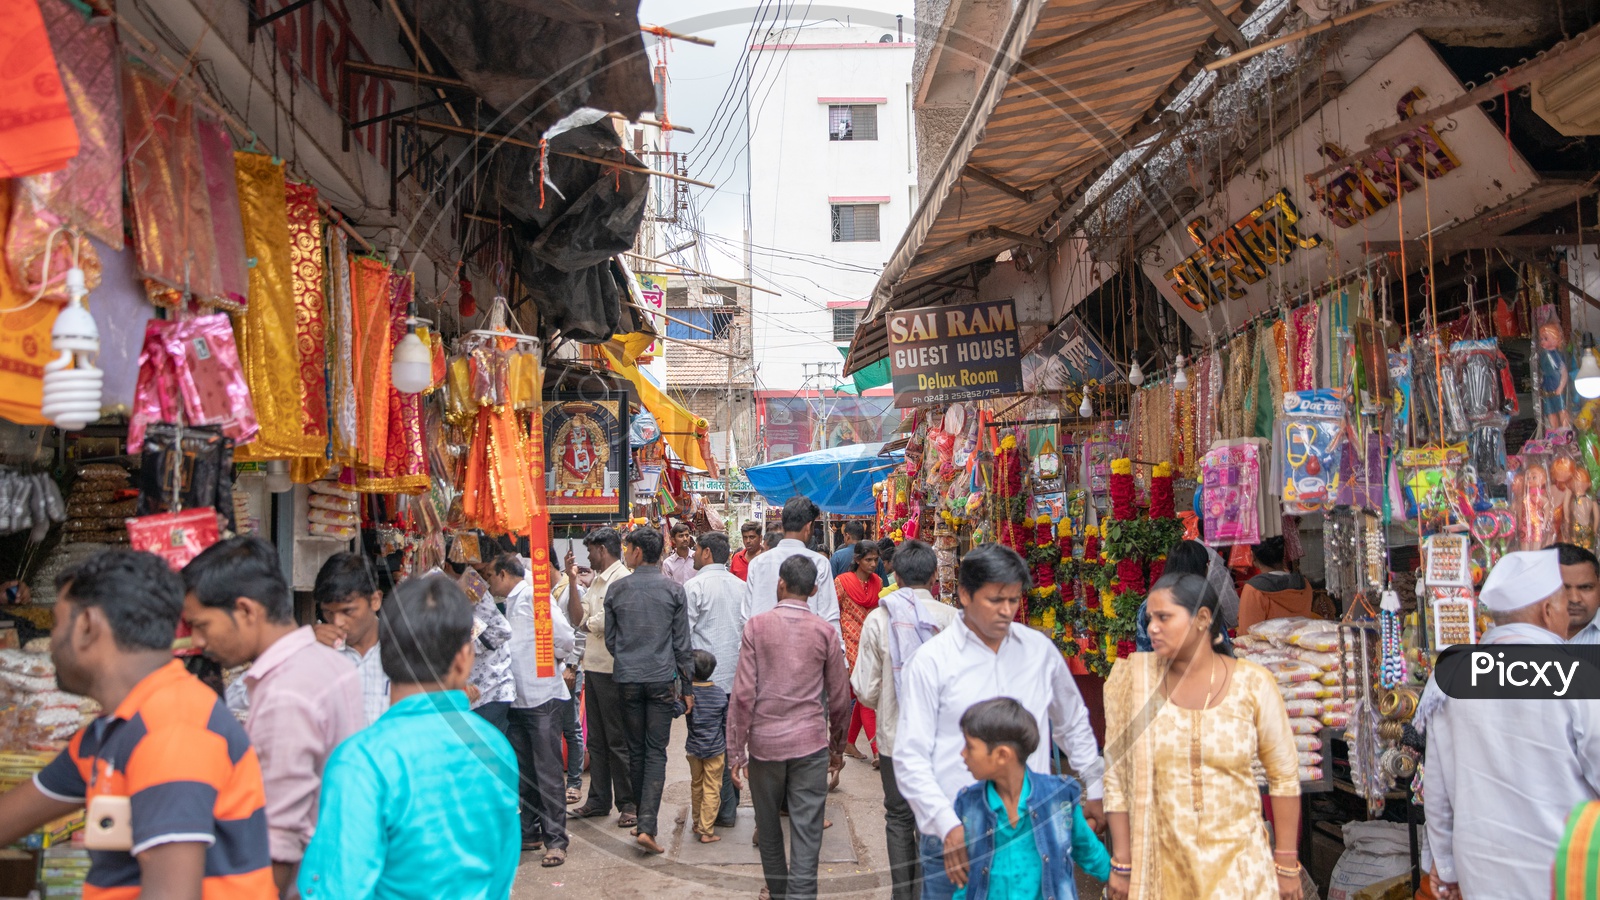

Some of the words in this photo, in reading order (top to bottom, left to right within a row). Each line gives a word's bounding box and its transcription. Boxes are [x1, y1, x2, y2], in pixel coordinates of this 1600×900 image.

[891, 313, 939, 344] SAI
[946, 304, 1017, 337] RAM
[895, 344, 948, 369] GUEST
[957, 337, 1016, 362] HOUSE
[918, 372, 957, 390] Delux
[960, 369, 999, 386] Room
[924, 394, 949, 403] 02423
